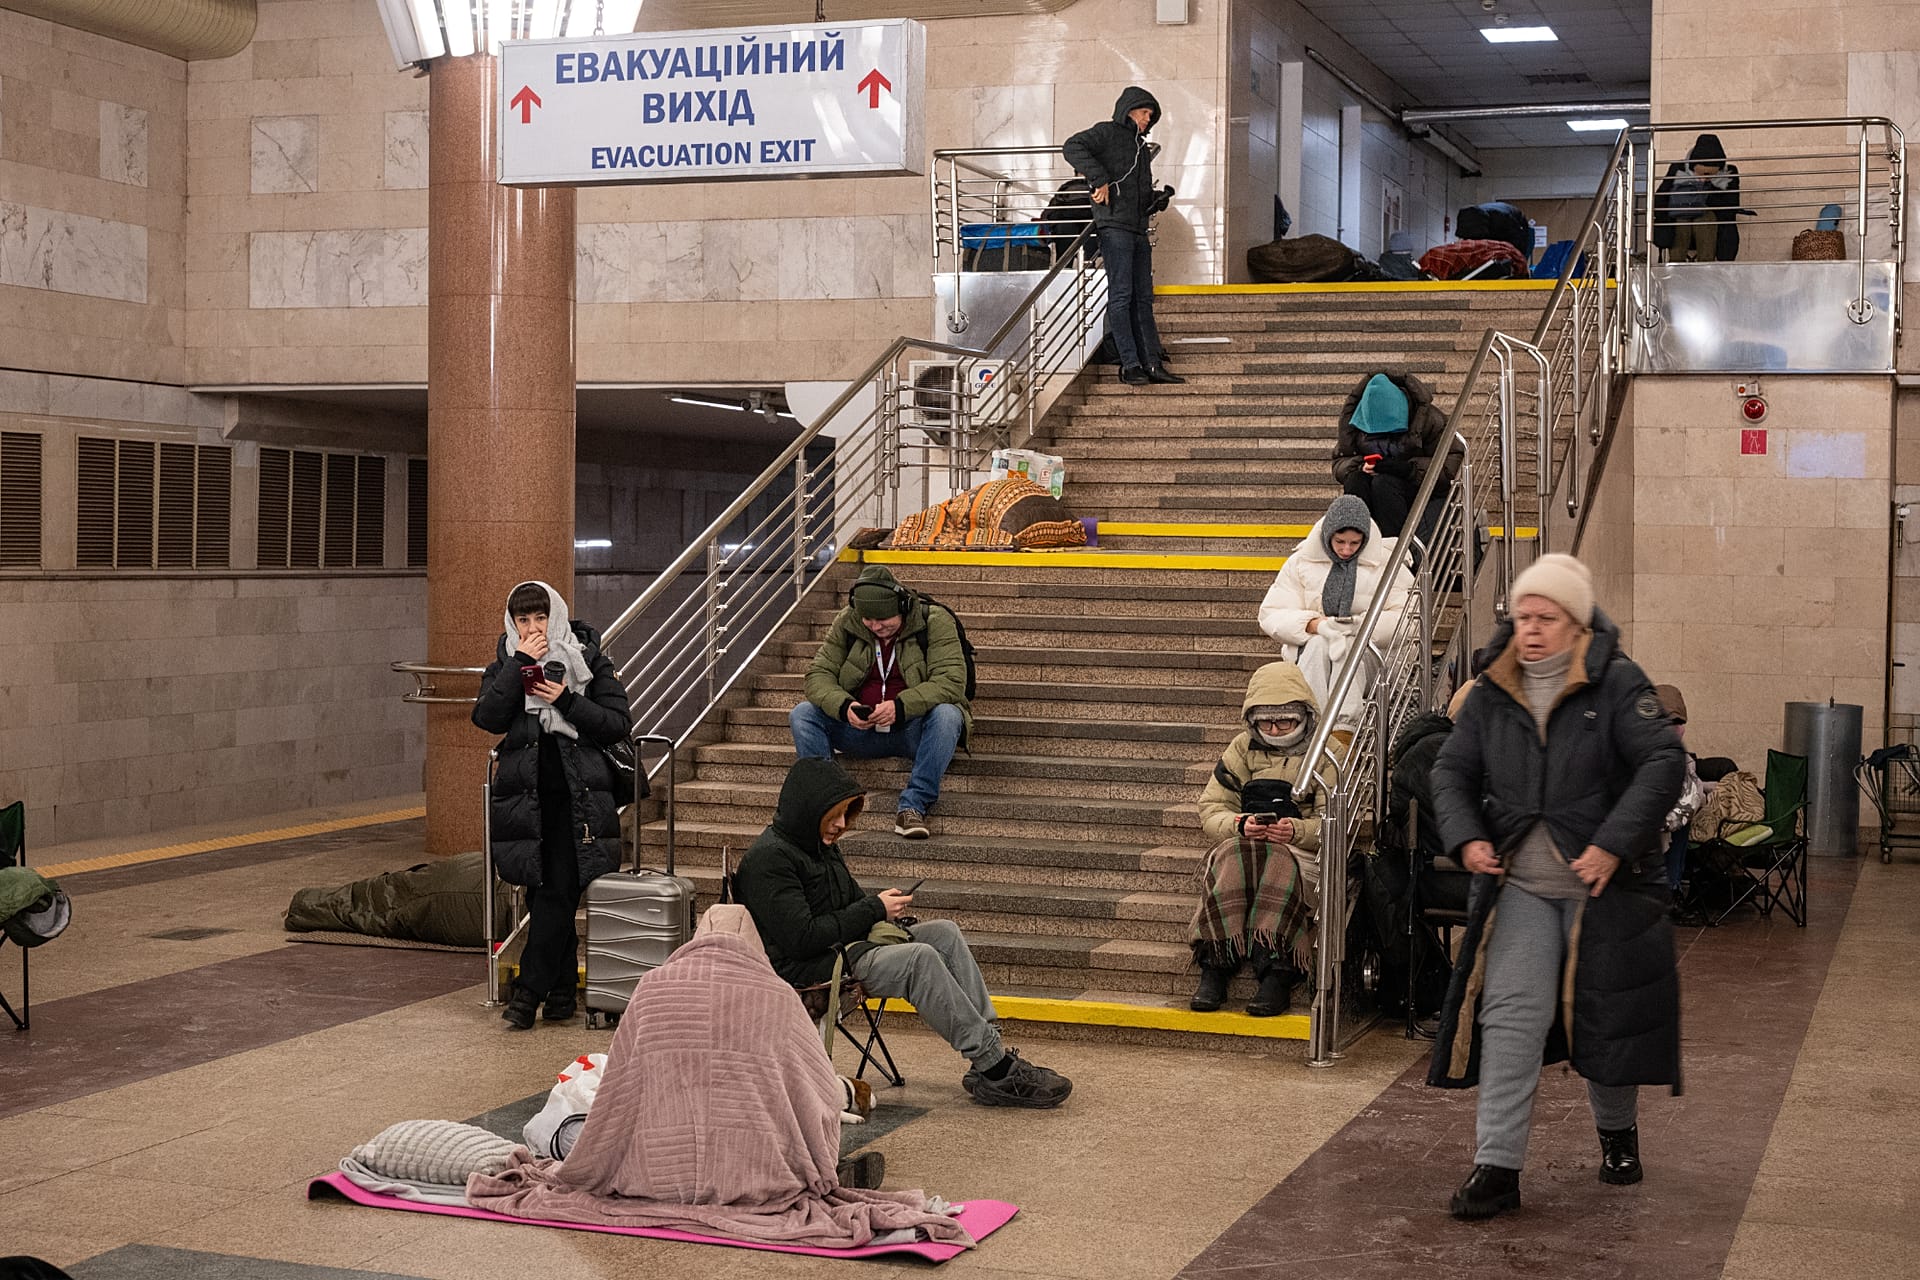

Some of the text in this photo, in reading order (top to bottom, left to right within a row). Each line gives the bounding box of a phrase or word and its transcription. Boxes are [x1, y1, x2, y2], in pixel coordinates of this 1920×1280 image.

[555, 31, 845, 84] ЕВАКУАЦІЙНИЙ
[642, 89, 755, 126] ВИХІД
[591, 139, 817, 170] EVACUATION EXIT
